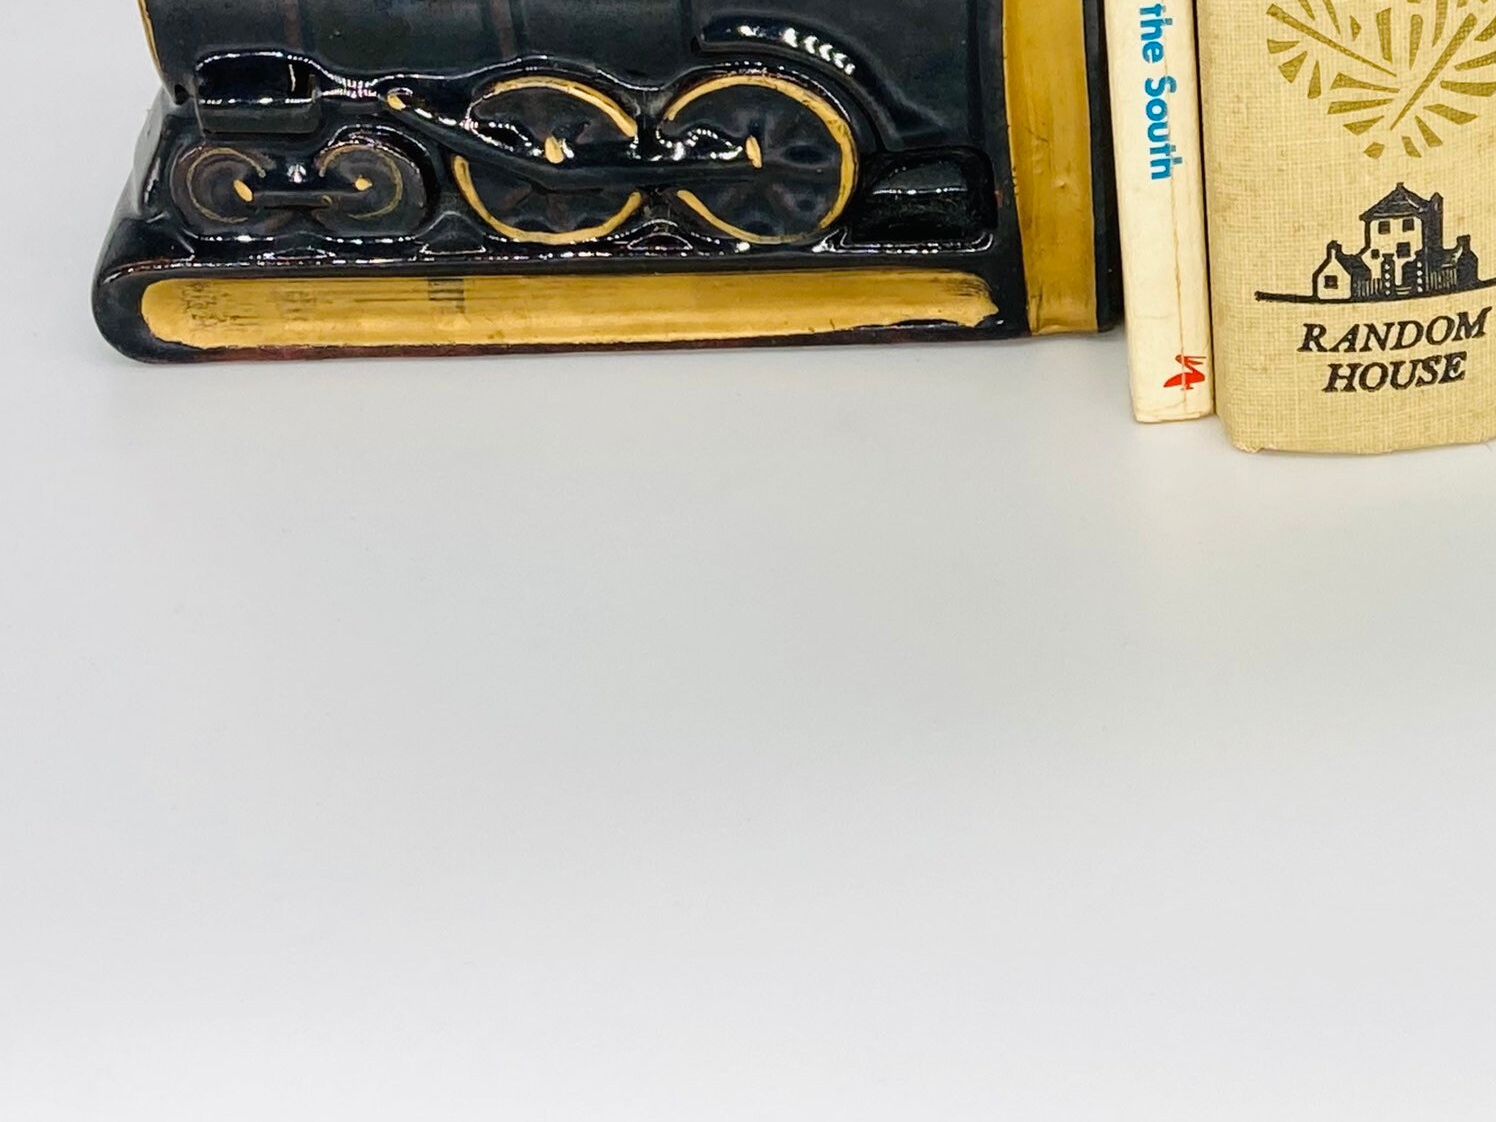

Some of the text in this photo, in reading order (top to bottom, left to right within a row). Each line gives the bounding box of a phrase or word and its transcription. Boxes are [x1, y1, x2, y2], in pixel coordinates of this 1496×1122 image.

[1139, 3, 1173, 63] the
[1144, 75, 1182, 181] South
[1297, 305, 1492, 353] RANDOM
[1321, 351, 1468, 394] HOUSE
